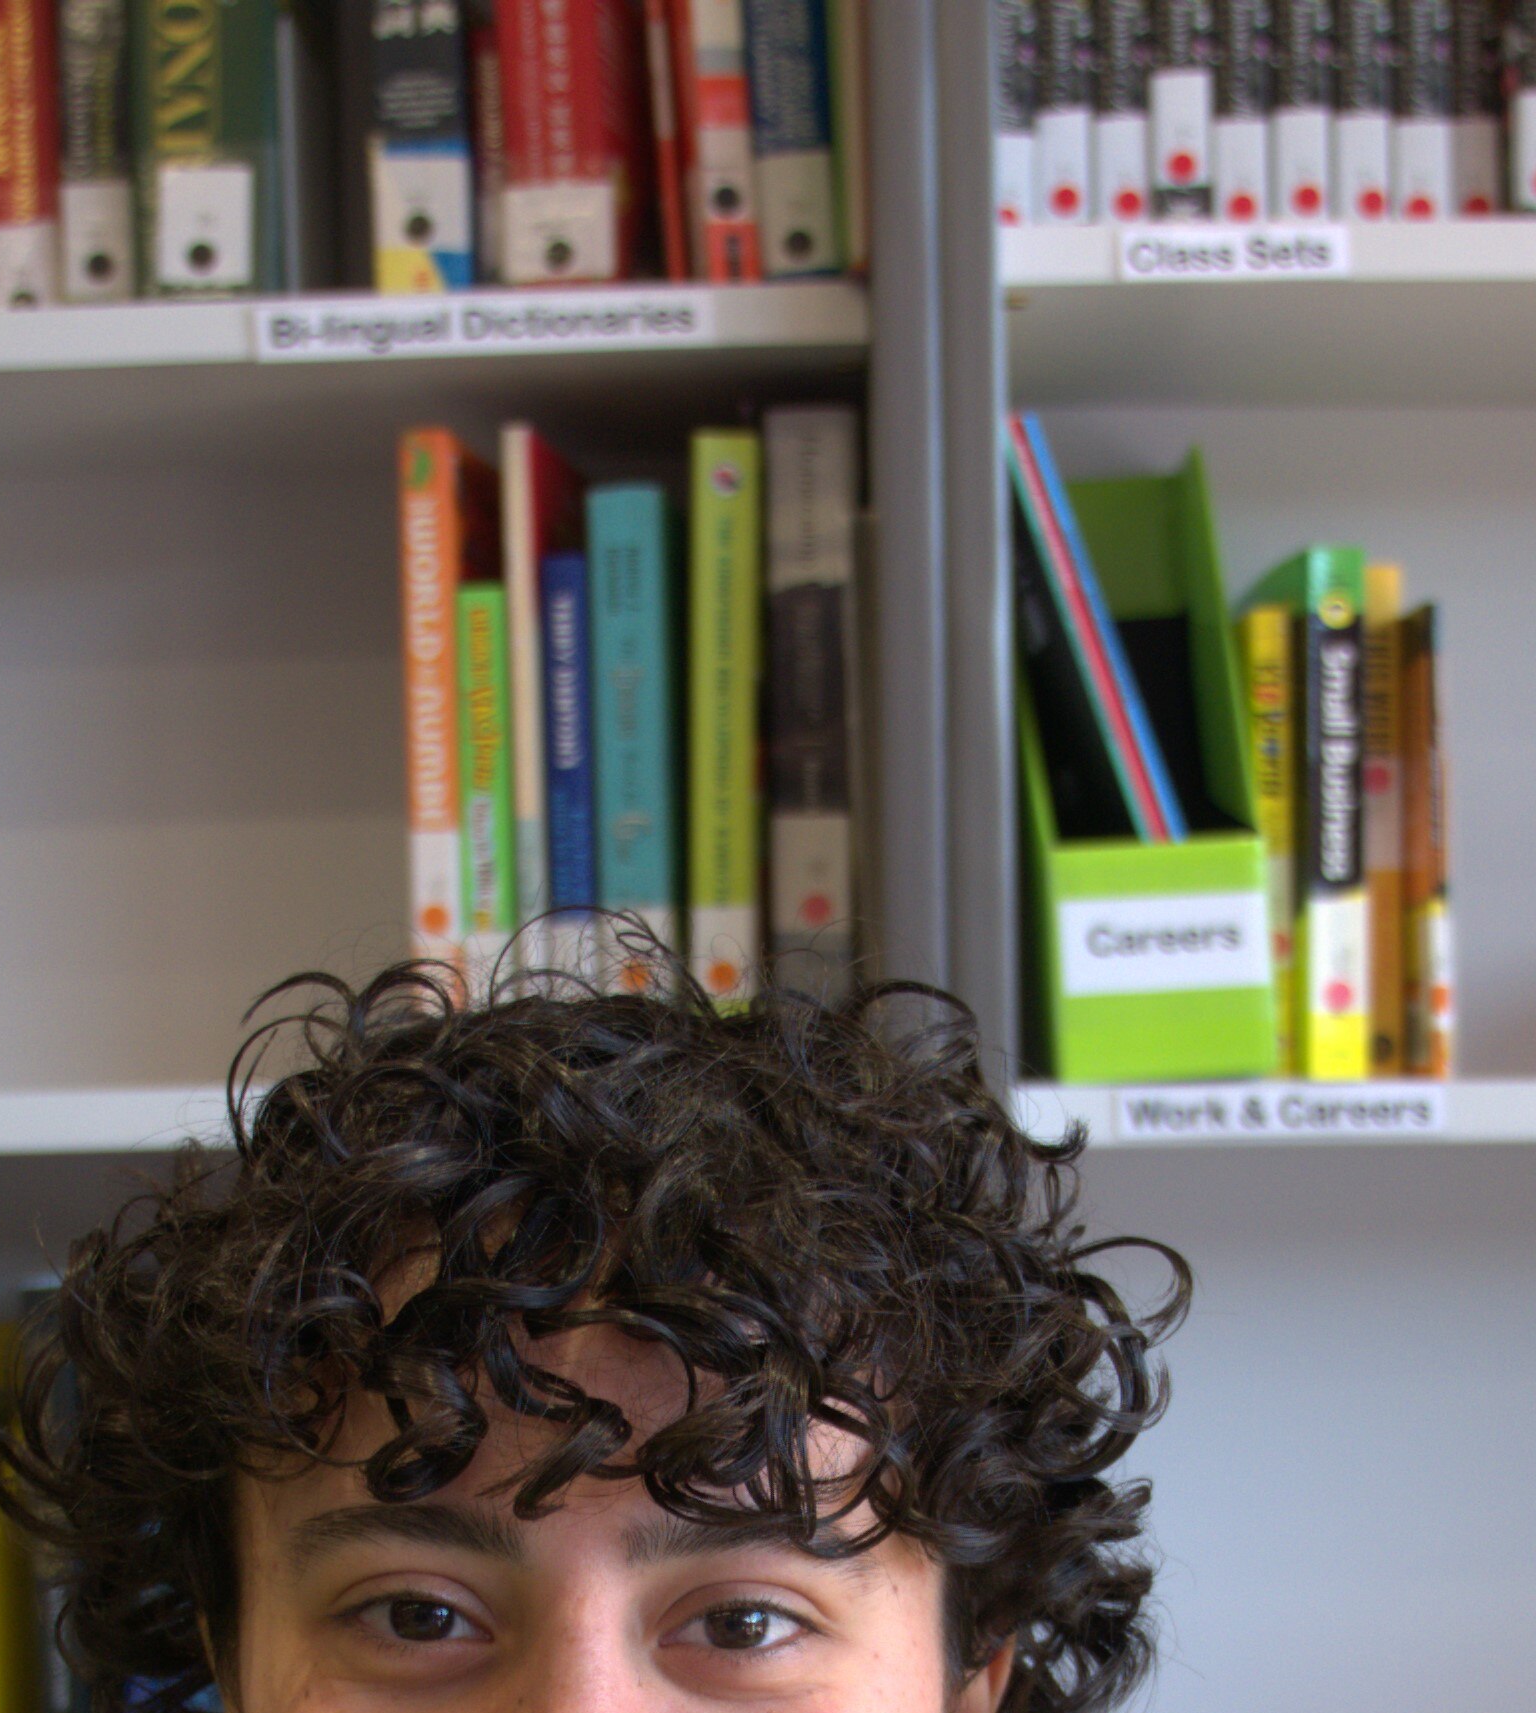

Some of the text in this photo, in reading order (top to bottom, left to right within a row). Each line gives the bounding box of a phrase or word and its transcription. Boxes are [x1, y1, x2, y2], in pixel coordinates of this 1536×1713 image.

[1128, 237, 1335, 274] Class Sets
[269, 303, 696, 355] Bi-lingual Dictionaries
[1319, 641, 1359, 883] Small Business
[1085, 919, 1243, 957] Careers
[1124, 1096, 1431, 1133] Work & Careers
